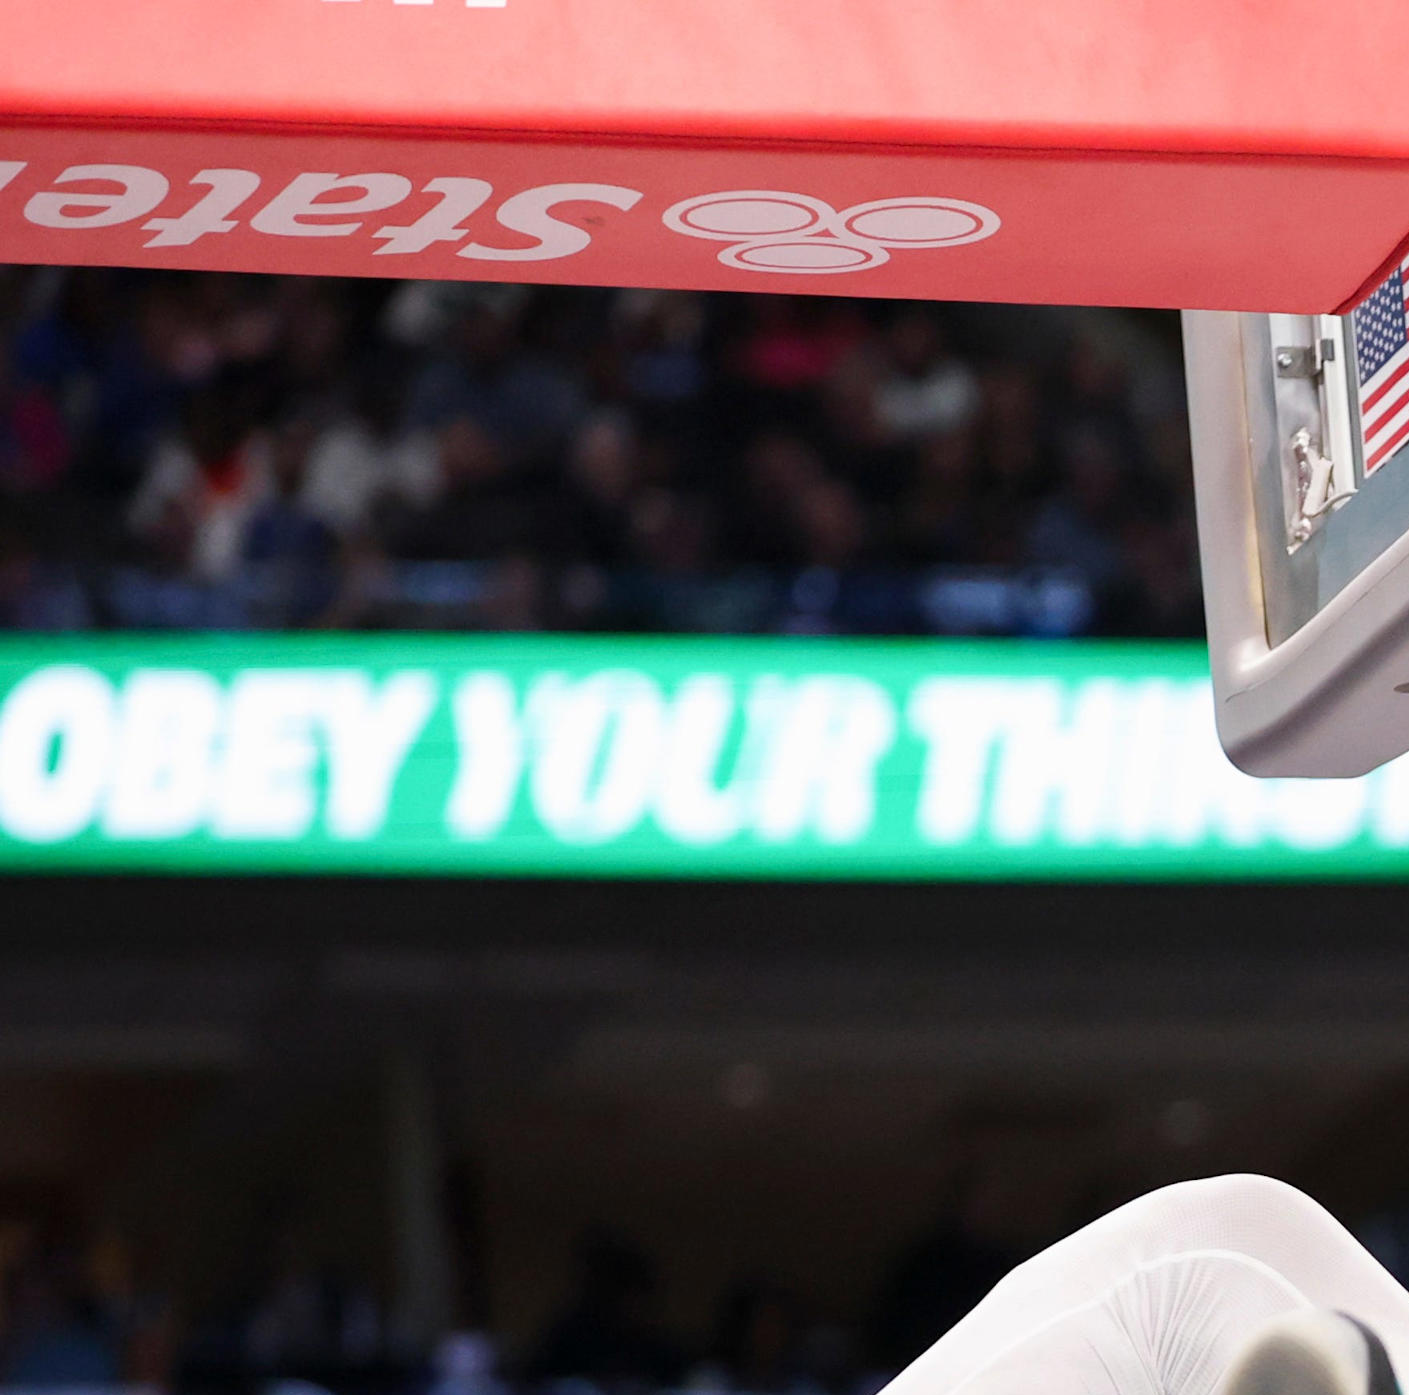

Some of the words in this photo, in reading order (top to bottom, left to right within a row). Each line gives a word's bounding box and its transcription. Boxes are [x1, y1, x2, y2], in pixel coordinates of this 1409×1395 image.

[0, 161, 643, 262] State
[0, 668, 430, 842] OBEY
[447, 670, 890, 846] YOUR
